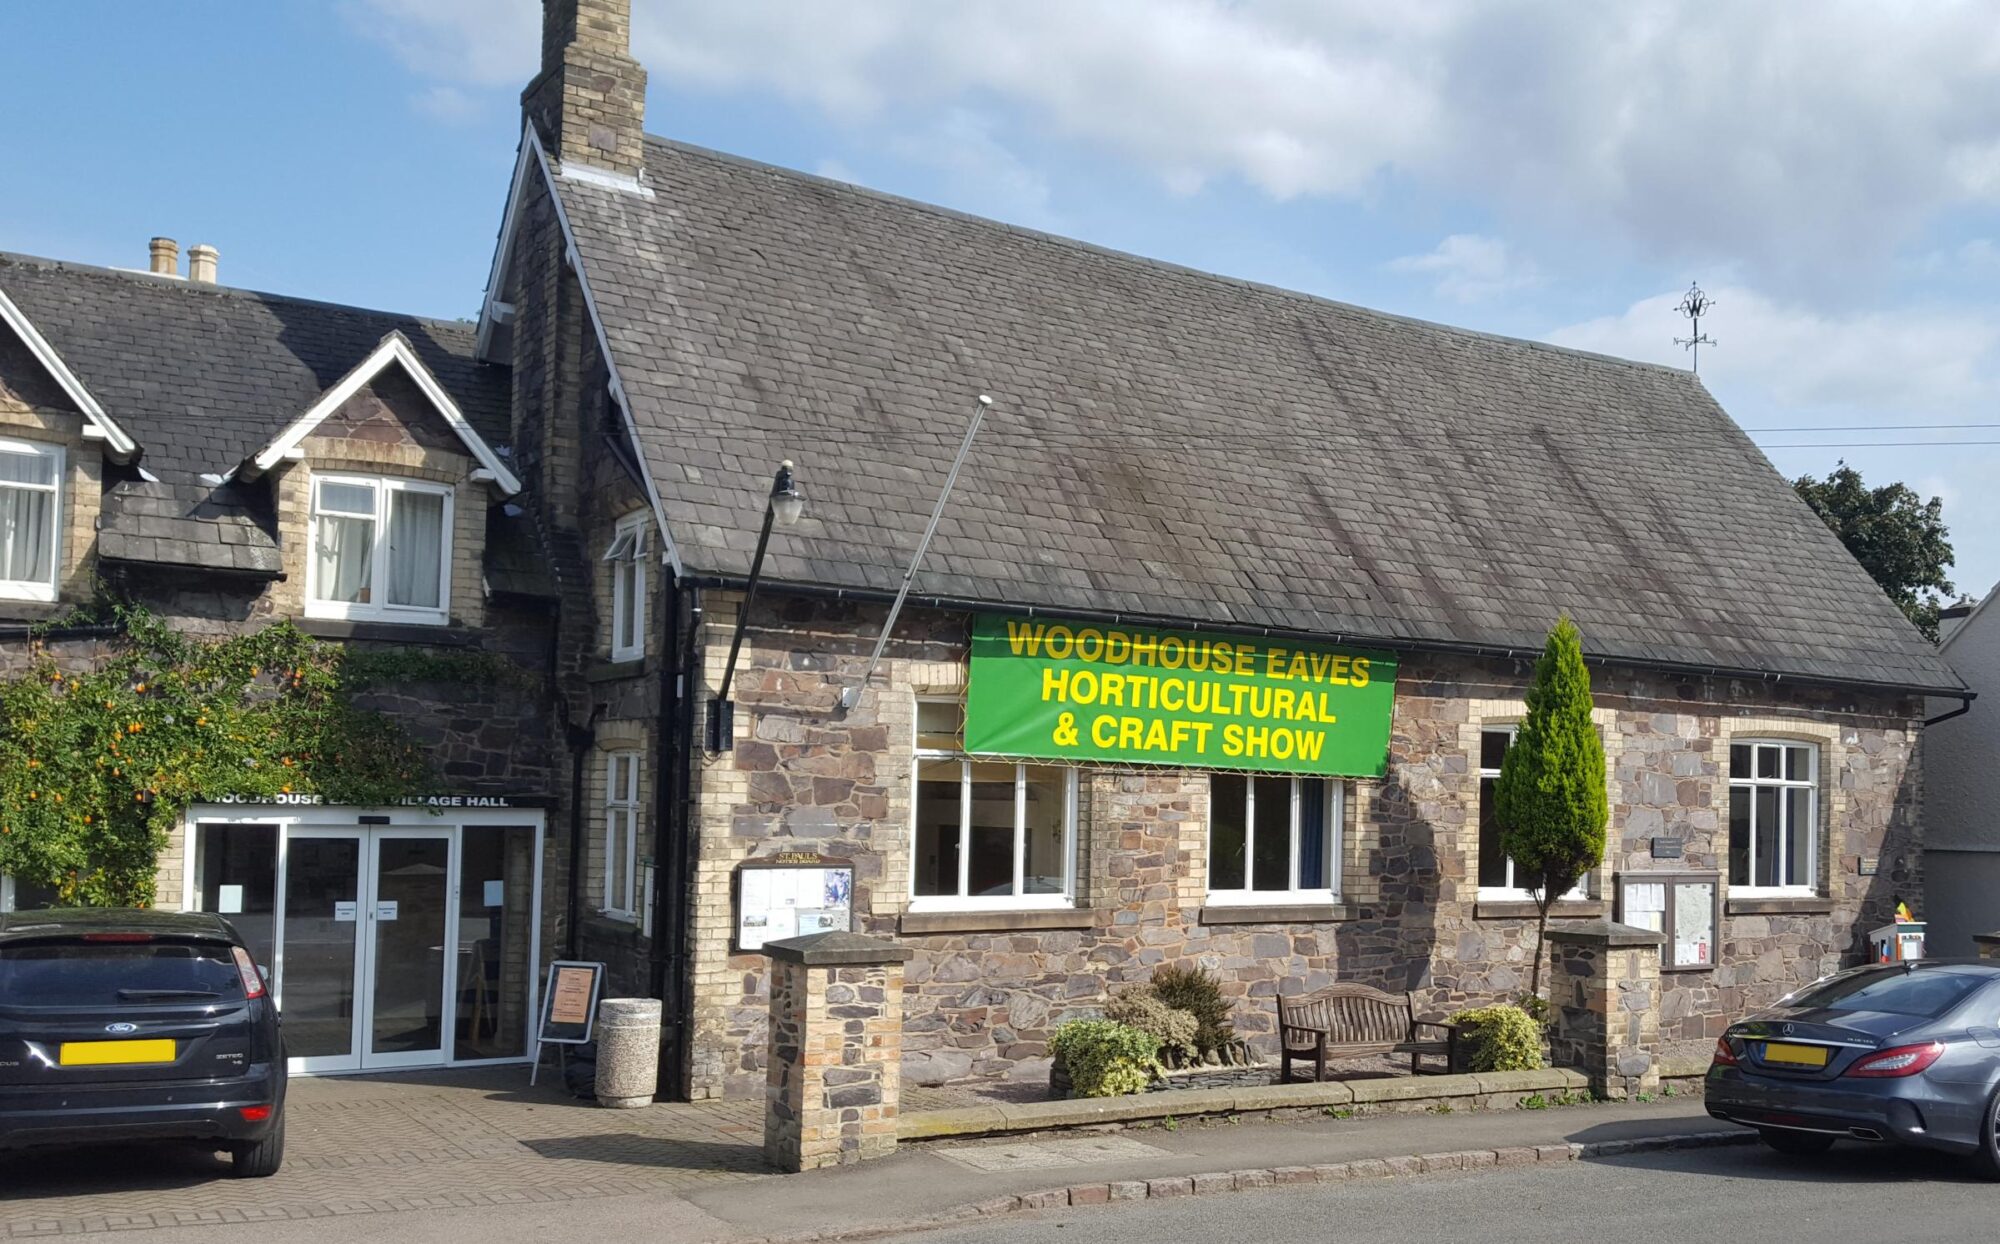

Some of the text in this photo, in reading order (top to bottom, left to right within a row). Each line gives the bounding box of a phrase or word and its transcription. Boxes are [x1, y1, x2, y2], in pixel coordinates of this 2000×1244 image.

[1007, 621, 1371, 688] WOODHOUSE EAVES
[1041, 668, 1337, 724] HORTICULTURAL
[1052, 712, 1326, 761] & CRAFT SHOW
[466, 796, 509, 807] HALL
